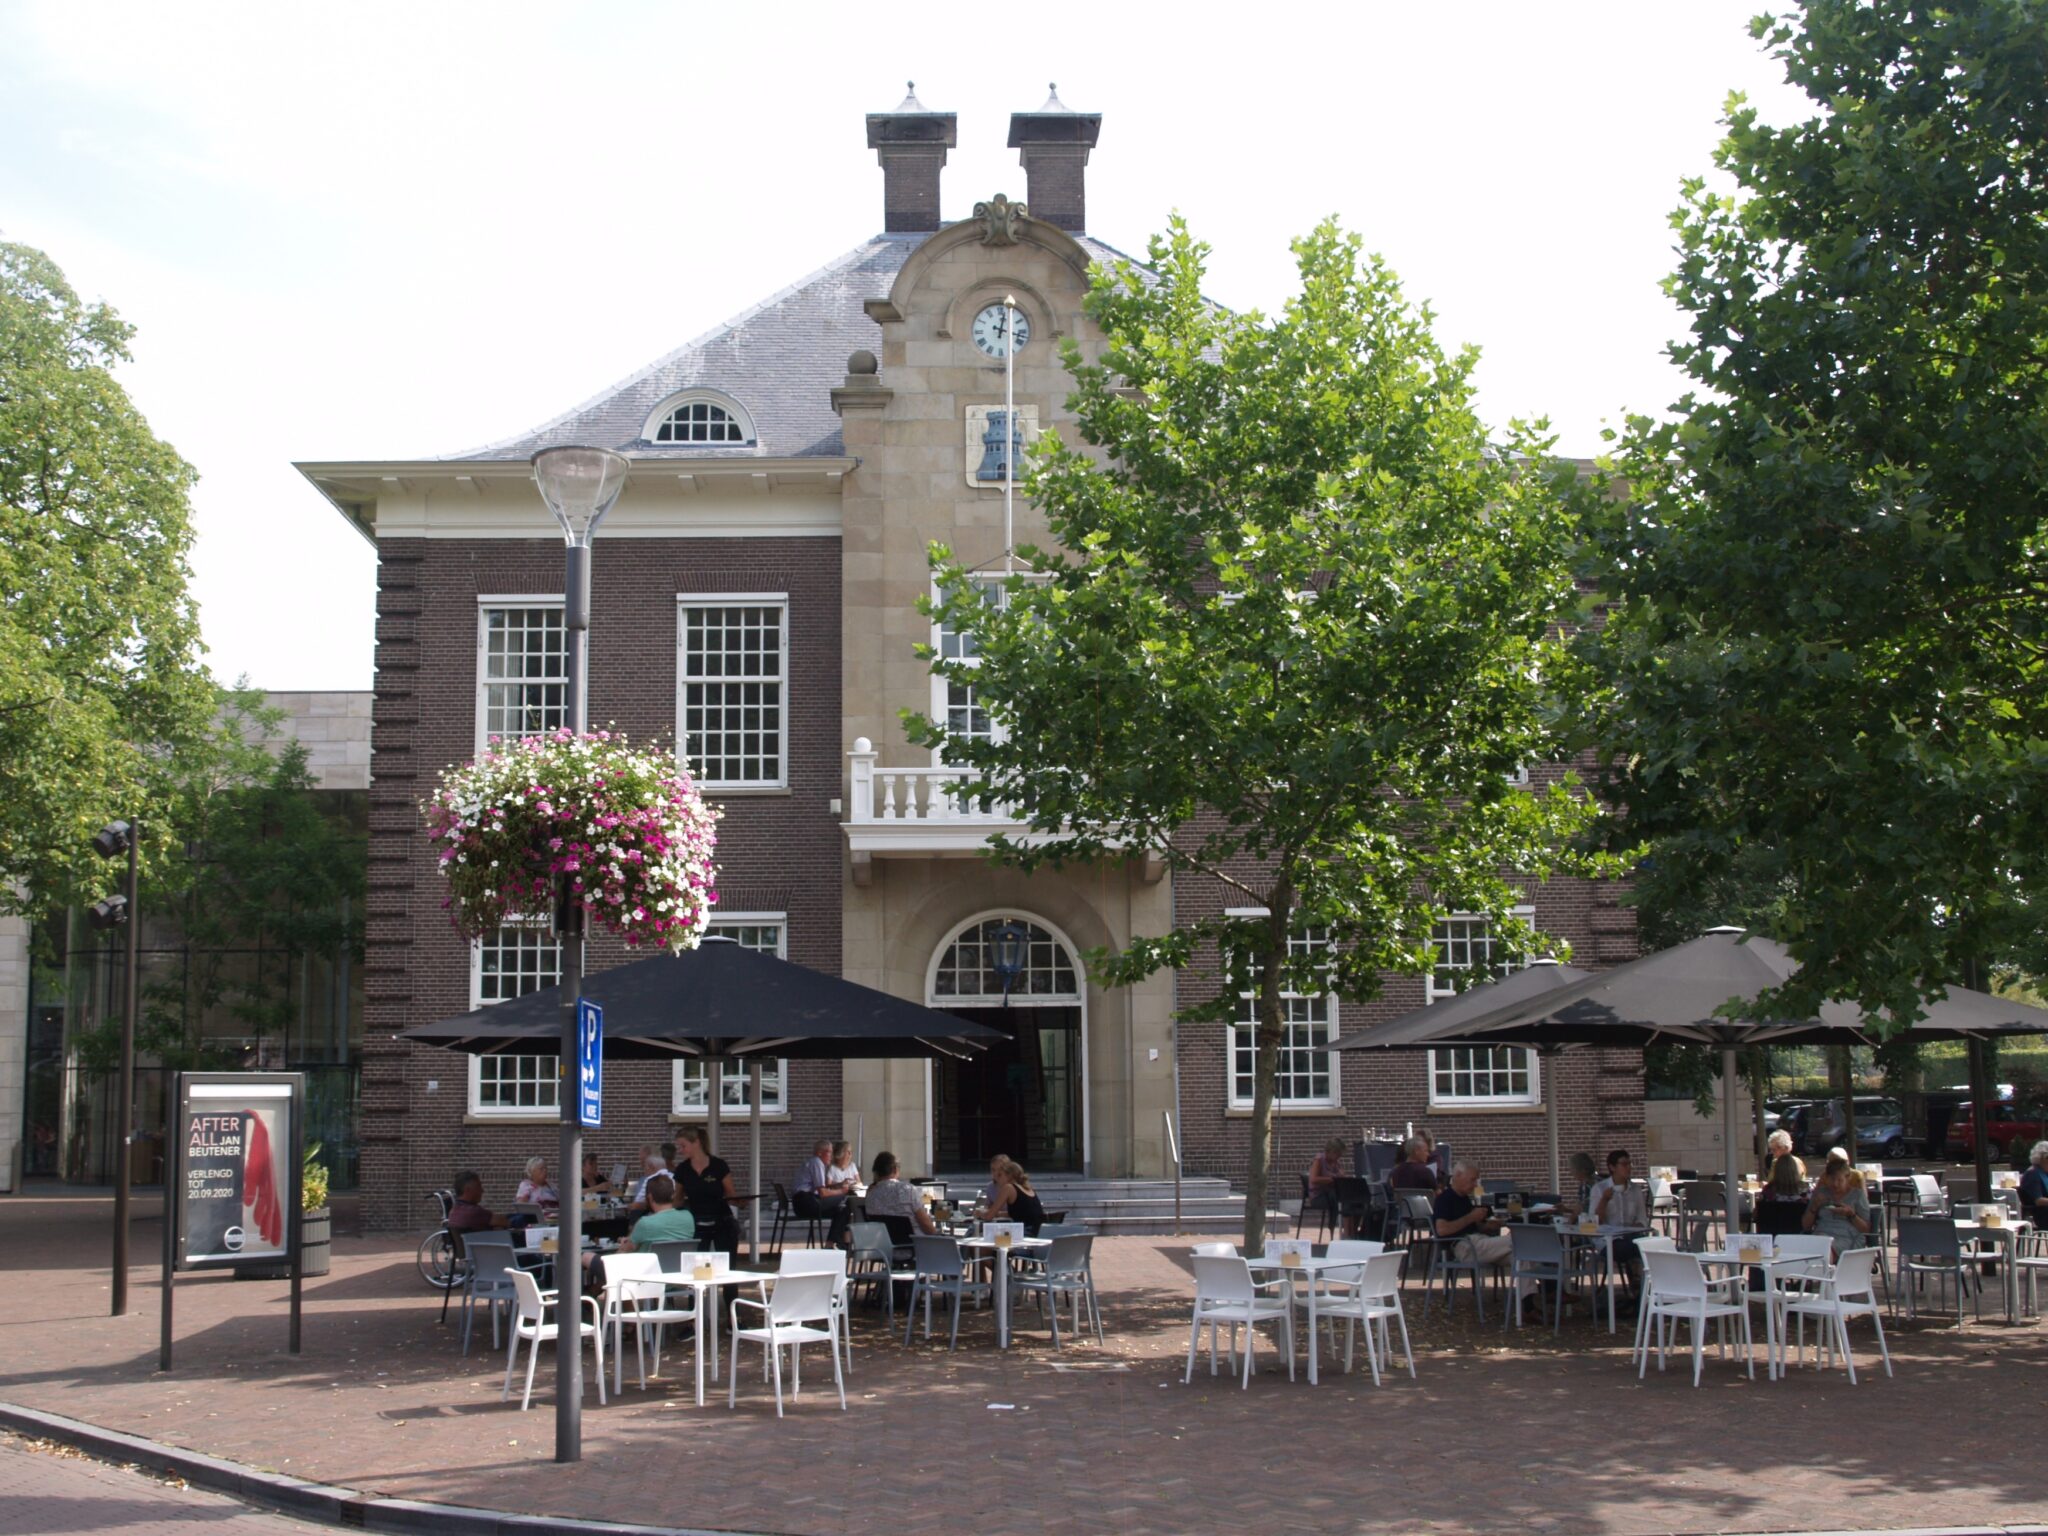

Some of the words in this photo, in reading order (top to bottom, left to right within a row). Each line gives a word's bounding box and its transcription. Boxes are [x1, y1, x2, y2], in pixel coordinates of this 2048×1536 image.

[587, 1009, 597, 1060] P
[190, 1117, 240, 1132] AFTER
[190, 1132, 219, 1146] ALL
[219, 1135, 240, 1146] JAN
[189, 1146, 240, 1157] BEUTENER
[187, 1169, 234, 1179] VERLENGD
[188, 1179, 206, 1189] TOT
[188, 1188, 234, 1199] 20.09.2020
